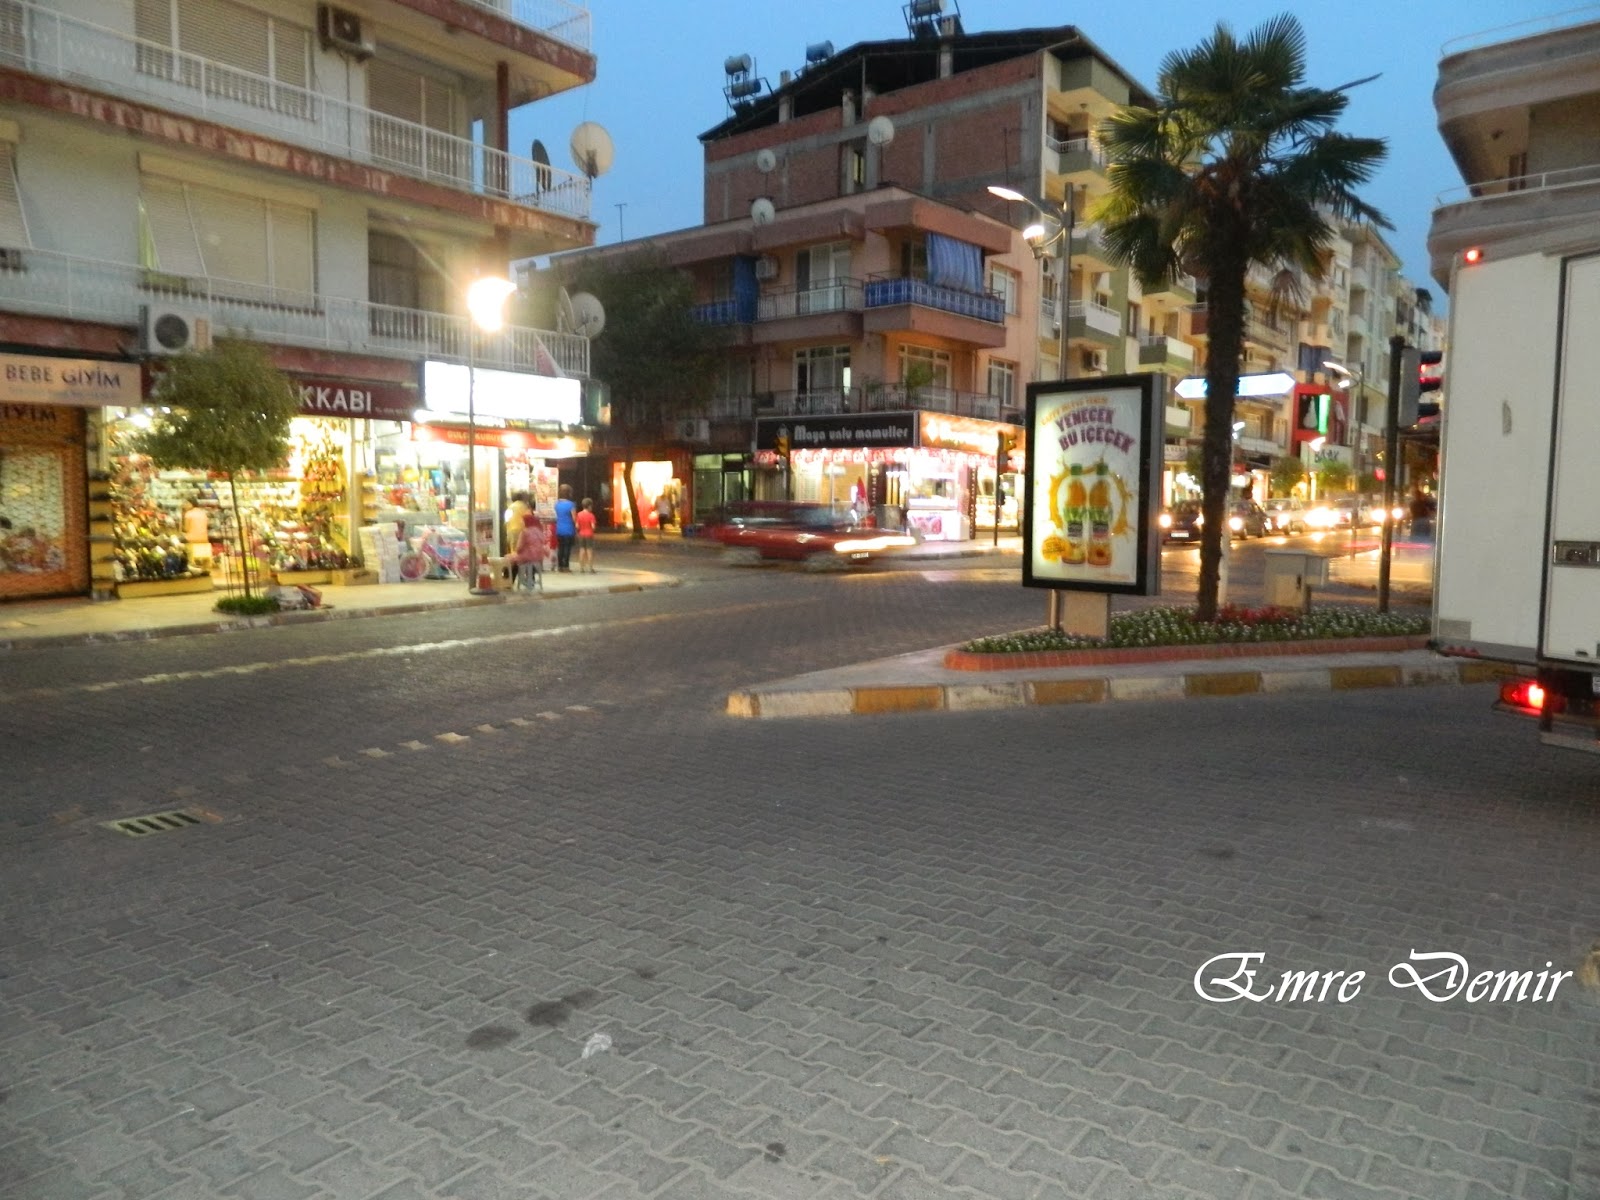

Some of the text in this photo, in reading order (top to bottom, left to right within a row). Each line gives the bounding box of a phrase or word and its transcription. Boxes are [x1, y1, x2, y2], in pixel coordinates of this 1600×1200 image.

[6, 364, 53, 382] BEBE
[1054, 406, 1115, 432] YENECEK
[794, 425, 826, 444] Maya
